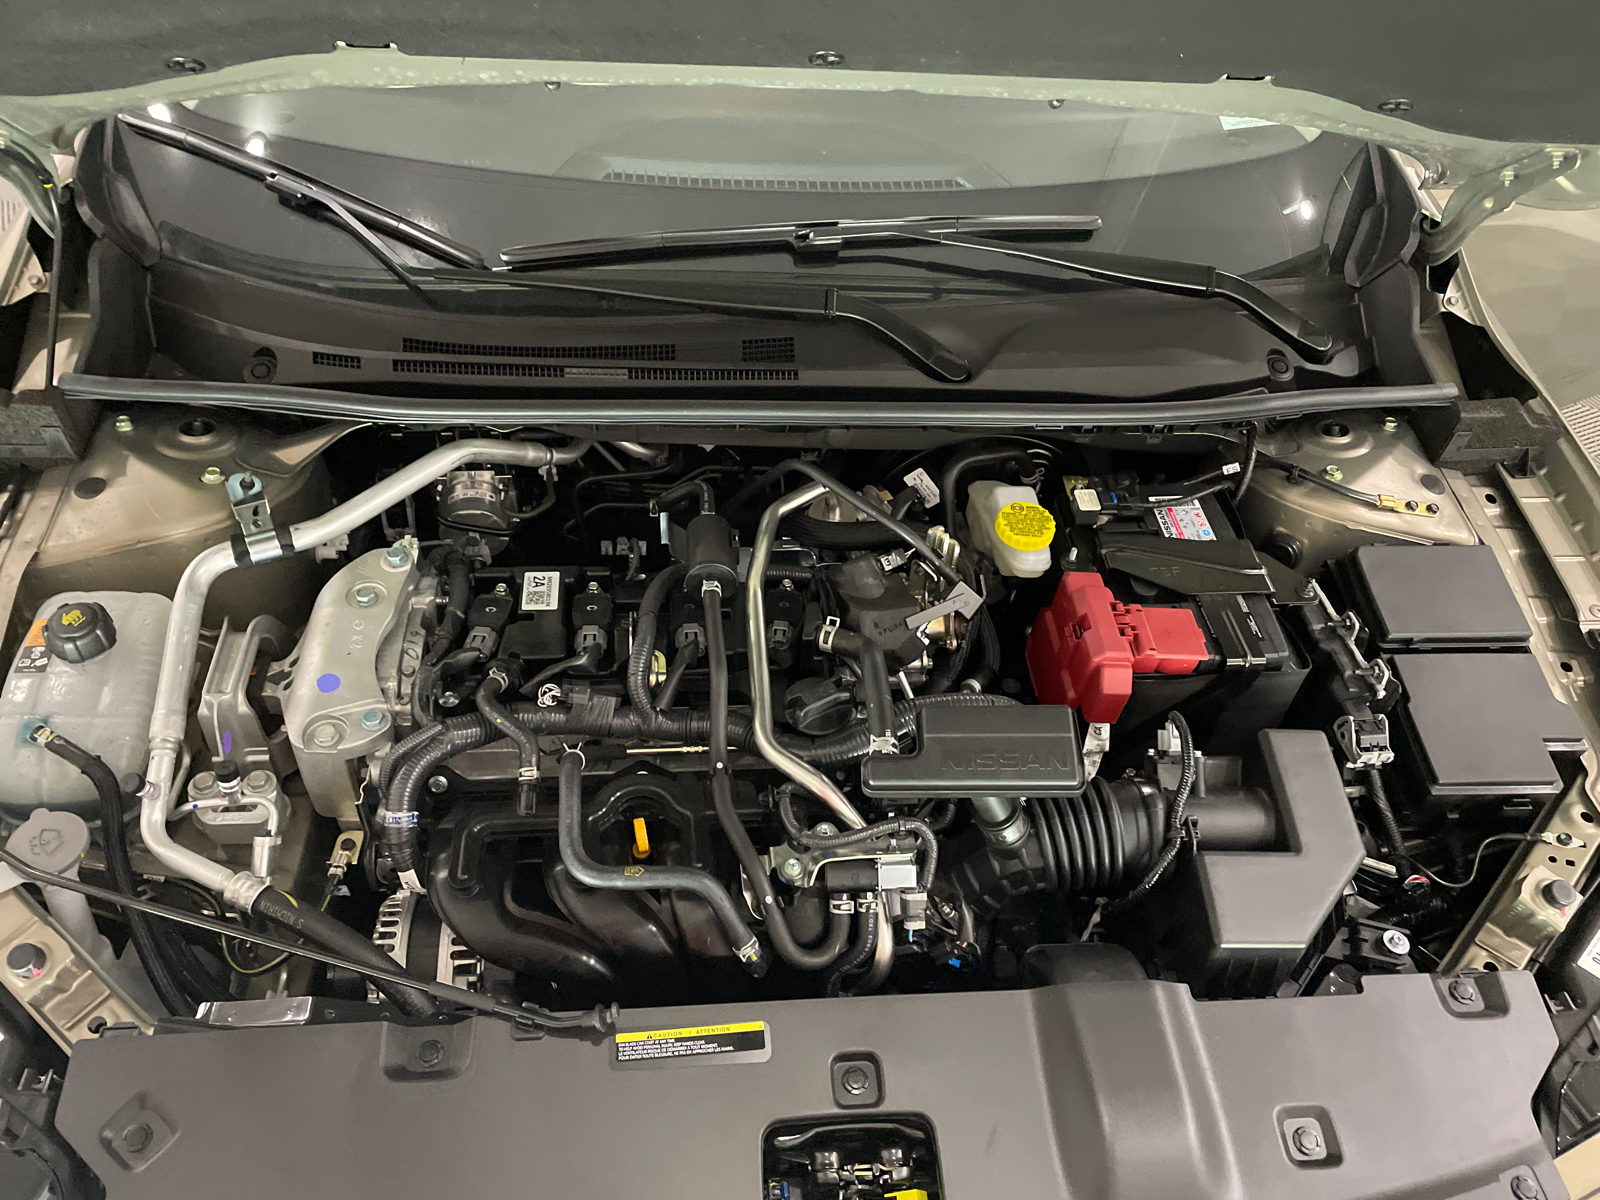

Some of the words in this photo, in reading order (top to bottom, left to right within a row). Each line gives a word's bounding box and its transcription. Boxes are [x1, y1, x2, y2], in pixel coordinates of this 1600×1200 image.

[532, 576, 546, 588] 2A
[942, 753, 1070, 771] NISSAN
[653, 1030, 682, 1038] CAUTION
[695, 1026, 730, 1034] ATTENTION
